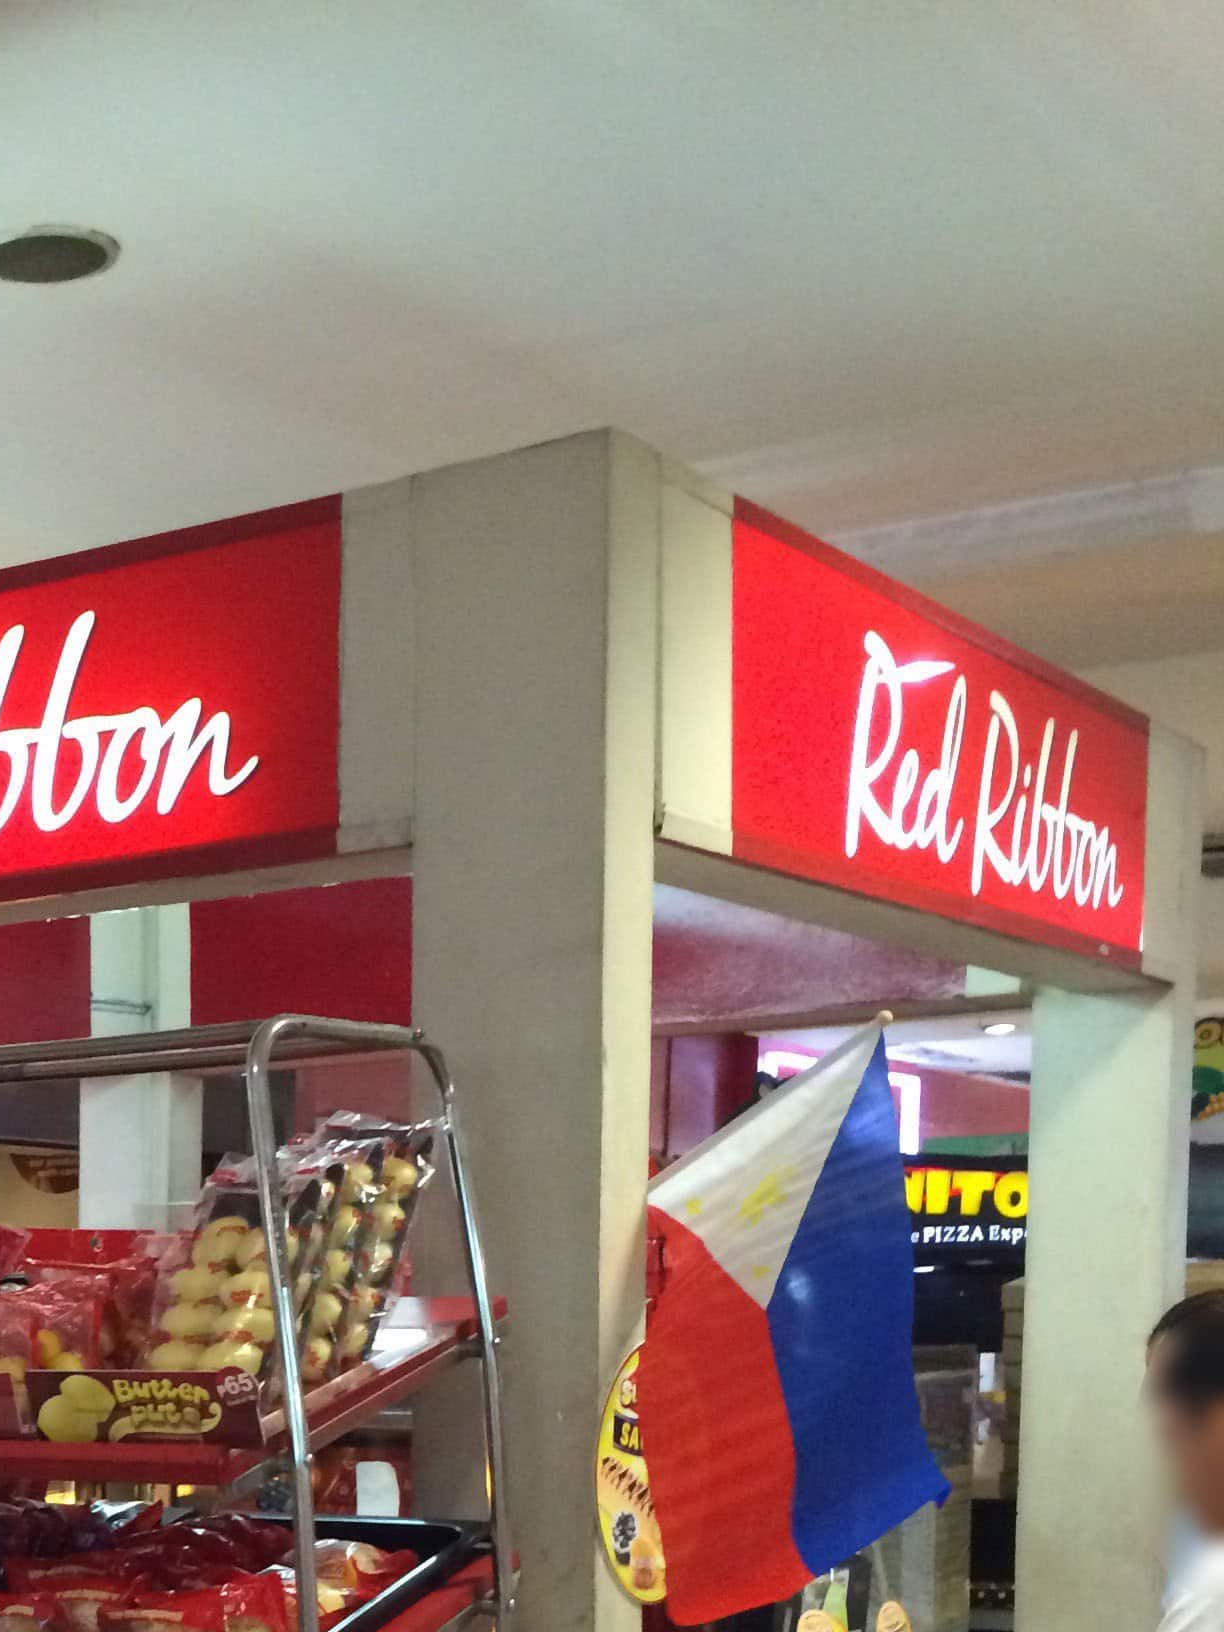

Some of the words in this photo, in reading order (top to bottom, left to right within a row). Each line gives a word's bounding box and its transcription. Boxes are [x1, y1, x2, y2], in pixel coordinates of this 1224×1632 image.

[846, 630, 966, 864] Red
[971, 689, 1124, 910] Ribbon
[923, 1225, 984, 1243] PIZZA
[989, 1224, 1028, 1245] Exp
[112, 1378, 210, 1404] Butter
